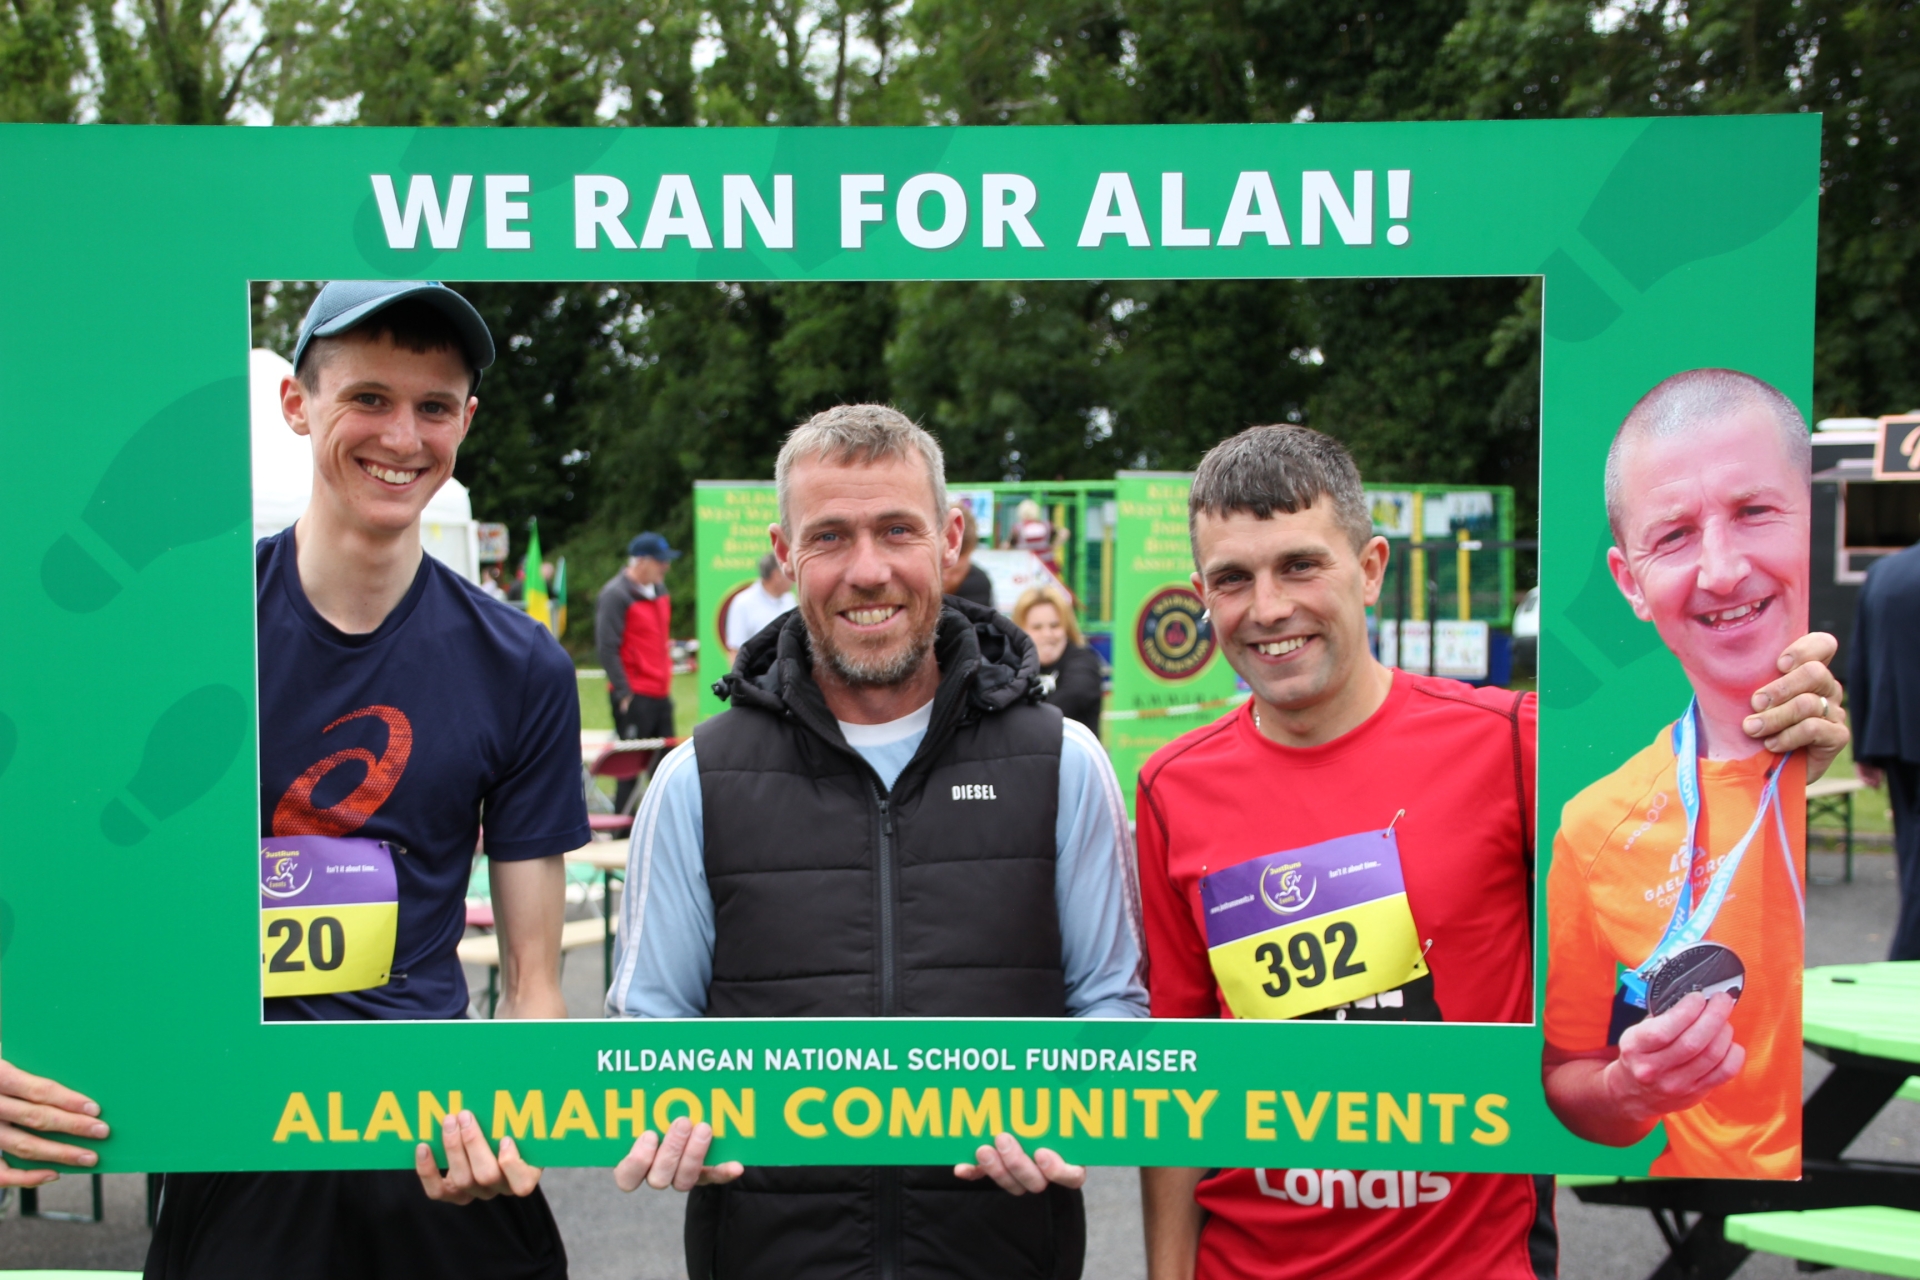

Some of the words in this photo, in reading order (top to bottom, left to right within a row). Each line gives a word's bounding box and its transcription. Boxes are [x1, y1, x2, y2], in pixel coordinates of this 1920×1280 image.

[370, 174, 533, 250] WE
[573, 174, 795, 250] RAN
[840, 171, 1046, 250] FOR
[1076, 169, 1412, 248] ALAN!
[951, 784, 997, 801] DIESEL
[262, 916, 345, 974] 20
[1254, 920, 1368, 998] 392
[597, 1048, 754, 1072] KILDANGAN
[764, 1047, 899, 1071] NATIONAL
[907, 1047, 1017, 1072] SCHOOL
[1025, 1048, 1198, 1073] FUNDRAISER
[271, 1090, 464, 1143] ALAN
[490, 1086, 757, 1140] MAHON
[782, 1086, 1220, 1139] COMMUNITY
[1245, 1089, 1511, 1146] EVENTS
